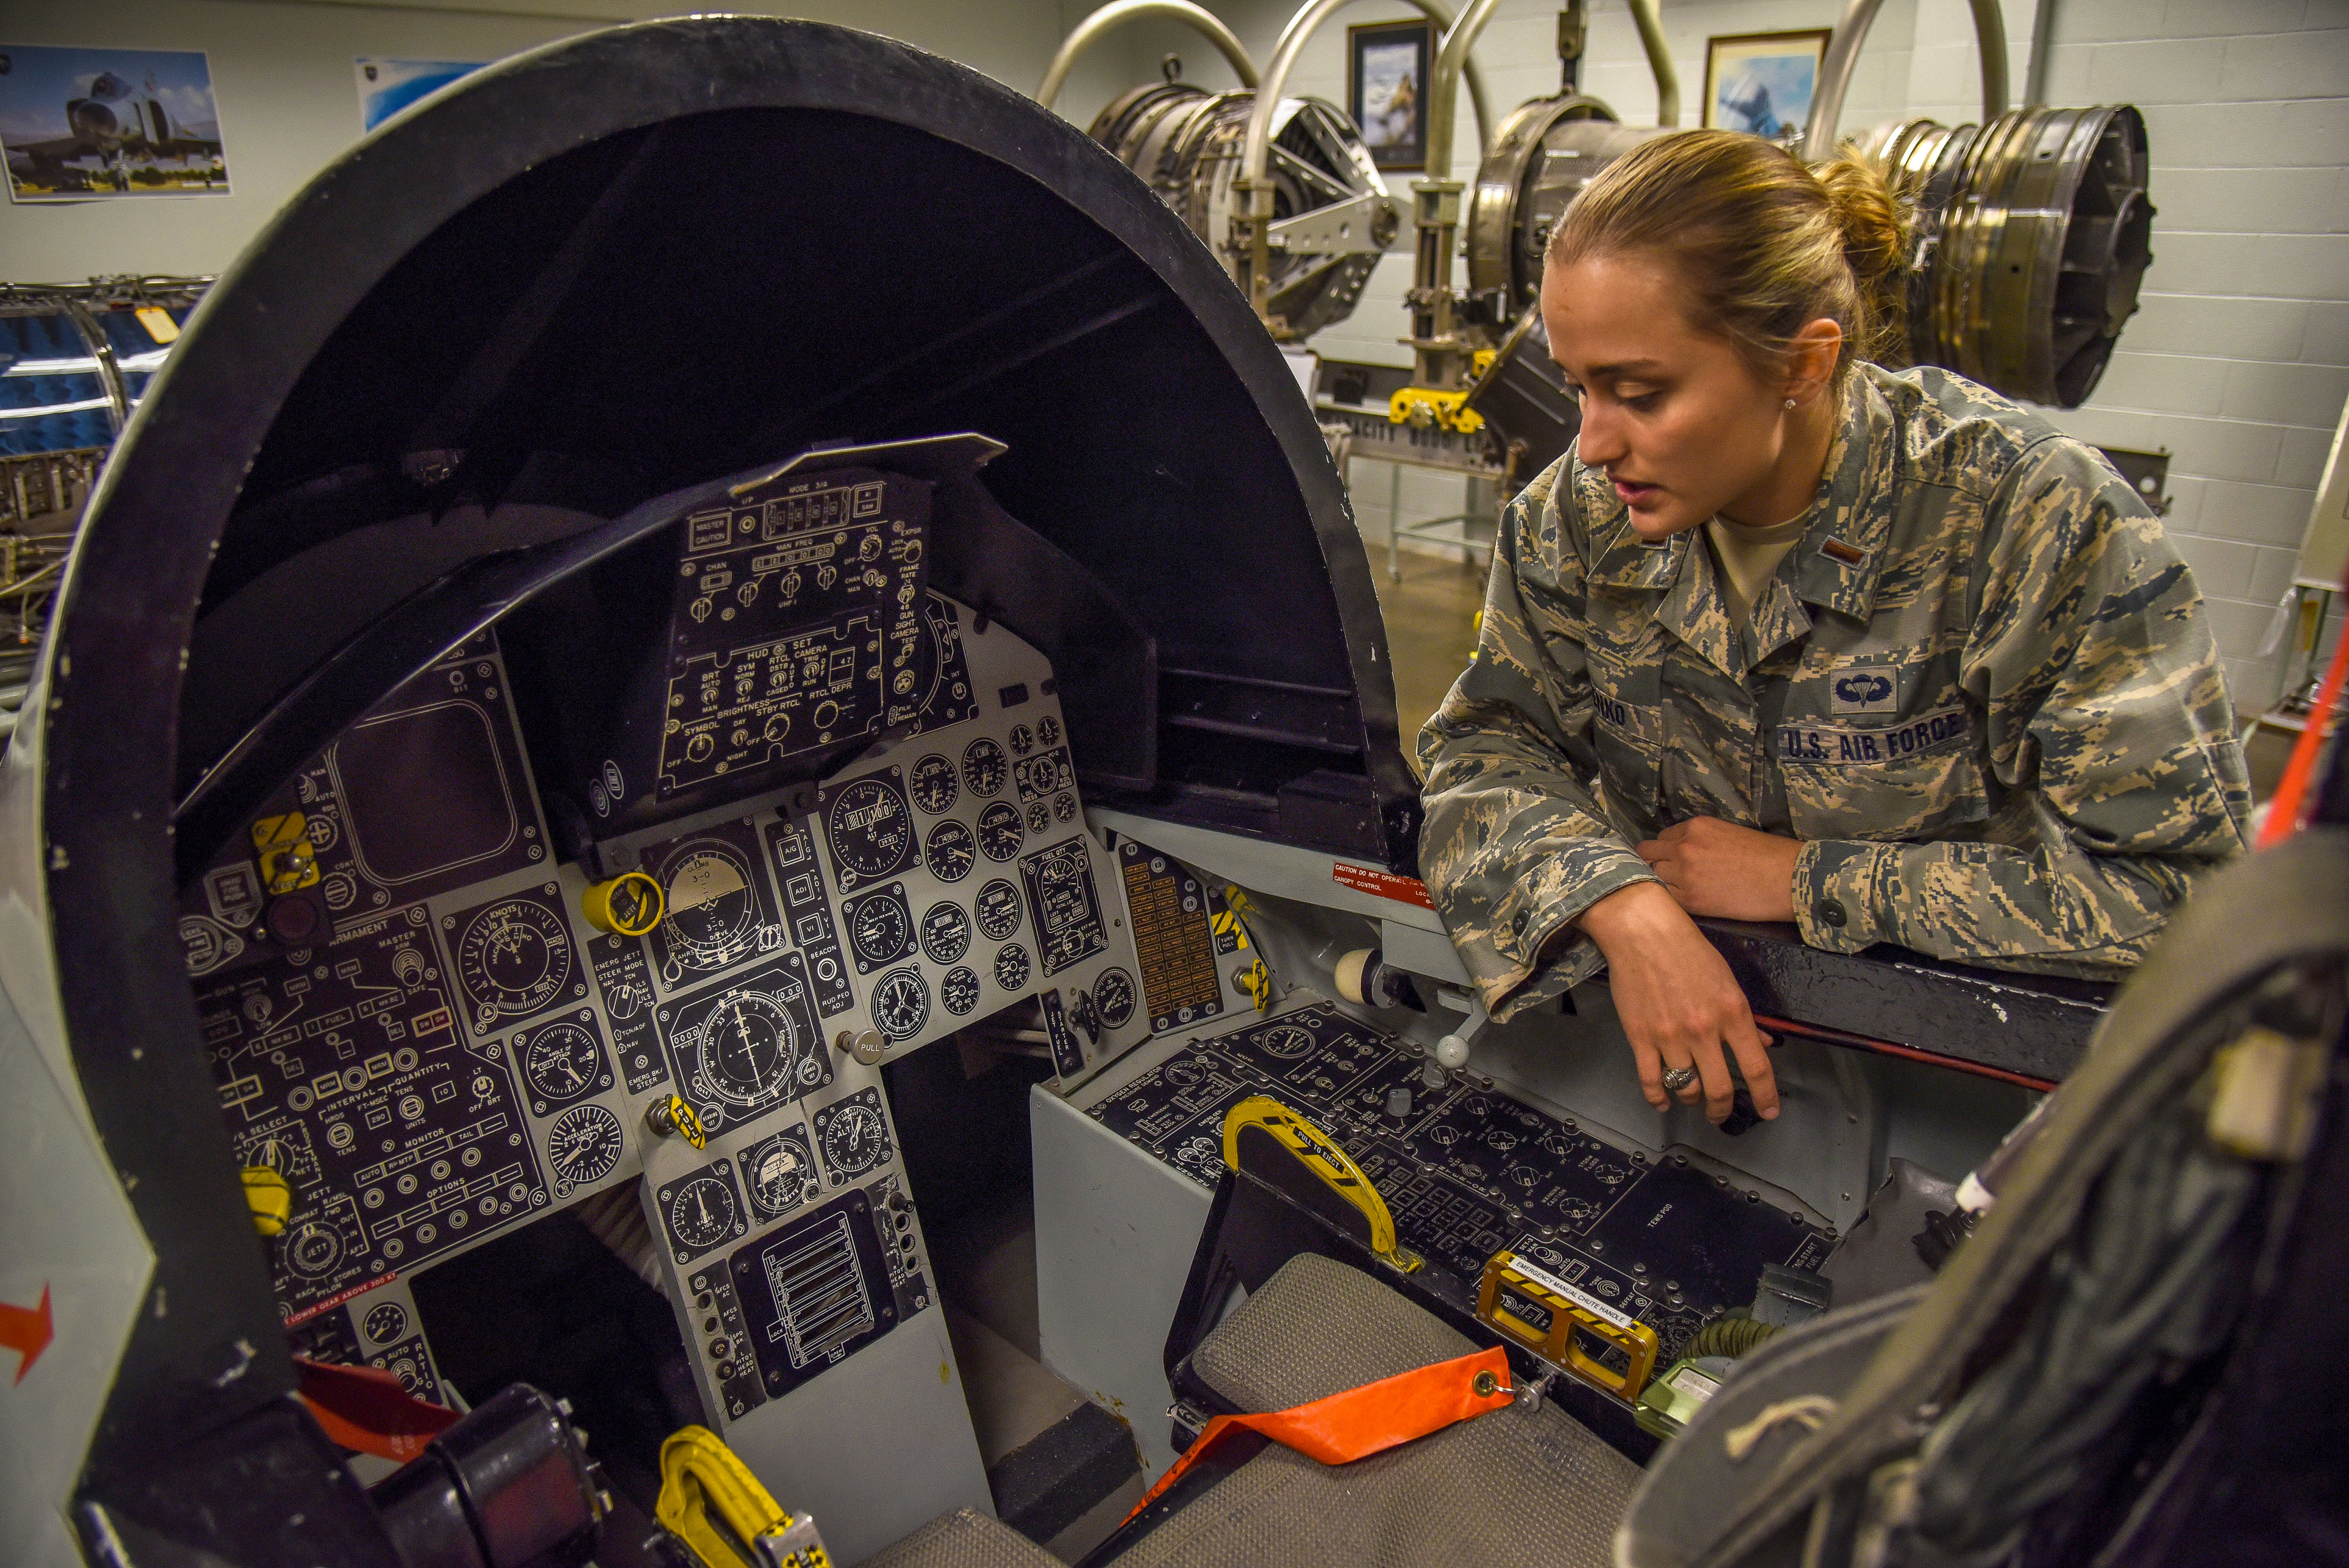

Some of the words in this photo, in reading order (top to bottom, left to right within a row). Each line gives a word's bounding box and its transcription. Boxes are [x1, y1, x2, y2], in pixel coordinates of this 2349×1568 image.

[706, 562, 726, 571] CHAN
[900, 564, 919, 572] FRAME
[900, 611, 914, 619] GUN
[896, 619, 915, 629] SIGHT
[891, 627, 919, 639] CAMERA
[748, 649, 768, 660] HUD
[793, 638, 812, 649] SET
[795, 645, 827, 658] CAMERA
[769, 656, 790, 664] RTCL
[738, 662, 755, 672] SYM
[770, 663, 788, 672] DSTB
[702, 671, 720, 681] BRT
[734, 671, 755, 680] NORM
[701, 680, 720, 689] AUTO
[809, 689, 829, 699] RTCL
[831, 682, 852, 693] DEPR
[766, 688, 788, 697] CAGED
[717, 697, 772, 719] BRIGHTNESS
[757, 705, 778, 716] STBY
[780, 699, 800, 709] RTCL
[734, 718, 746, 727] DAY
[898, 713, 916, 721] REMAIN
[685, 722, 720, 736] SYMBOL
[1788, 730, 1829, 759] U.S.
[1839, 734, 1881, 761] AIR
[1886, 713, 1962, 757] FORCE
[727, 750, 748, 761] NIGHT
[667, 759, 681, 768] OFF
[1021, 793, 1037, 803] PRESS
[868, 832, 877, 841] ALT
[882, 837, 896, 846] 29.92
[785, 846, 796, 854] A/G
[1042, 852, 1055, 861] FUEL
[1055, 847, 1066, 857] QTY
[1335, 865, 1357, 874] CAUTION
[1334, 876, 1354, 884] CANOPY
[1357, 881, 1381, 891] CONTROL
[796, 886, 806, 894] ADI
[490, 905, 517, 919] KNOTS
[379, 931, 416, 948] MASTER
[866, 934, 879, 943] DOWN
[678, 949, 695, 960] AHRS
[811, 945, 836, 959] BEACON
[595, 958, 619, 971] EMERG
[623, 950, 641, 962] JETT
[599, 968, 621, 980] STEER
[625, 960, 643, 971] MODE
[408, 985, 426, 995] SAFE
[638, 987, 648, 995] NAV
[643, 999, 654, 1008] TCN
[822, 997, 836, 1006] RUD
[836, 991, 850, 1001] PED
[831, 1001, 844, 1011] ADJ
[622, 1023, 645, 1035] TCN/ADF
[1057, 1011, 1069, 1051] STARTER
[861, 1043, 880, 1052] PULL
[1055, 1033, 1063, 1056] FUEL
[549, 1049, 564, 1058] ANGLE
[395, 1064, 440, 1085] QUANTITY
[472, 1067, 482, 1075] LT
[629, 1073, 653, 1087] EMERG
[651, 1067, 663, 1079] BK/
[636, 1076, 658, 1089] STEER
[1106, 1085, 1128, 1103] OXYGEN
[1128, 1066, 1163, 1089] REGULATOR
[395, 1085, 413, 1096] TENS
[327, 1089, 376, 1112] INTERVAL
[358, 1095, 390, 1114] FT-MSEC
[469, 1103, 483, 1113] OFF
[487, 1096, 501, 1106] BRT
[406, 1118, 426, 1129] UNITS
[678, 1108, 699, 1138] PULL
[1198, 1115, 1214, 1127] EMERG
[1212, 1109, 1223, 1118] GEN
[1209, 1116, 1220, 1125] AUTO
[251, 1117, 287, 1135] SELECT
[405, 1128, 445, 1148] MONITOR
[565, 1123, 602, 1142] ACCELERATION
[337, 1145, 356, 1156] TENS
[1297, 1131, 1312, 1146] PULL
[1314, 1143, 1321, 1153] TO
[1322, 1151, 1341, 1169] EJECT
[360, 1168, 381, 1182] AUTO
[307, 1187, 330, 1201] JETT
[427, 1178, 465, 1198] OPTIONS
[289, 1208, 318, 1224] COMBAT
[1648, 1213, 1663, 1227] TEWS
[1660, 1203, 1673, 1215] POD
[1519, 1238, 1533, 1250] SET-3
[1526, 1244, 1539, 1253] MAN
[1801, 1242, 1818, 1260] START
[1559, 1258, 1570, 1269] AUTO
[1806, 1256, 1821, 1269] FUEL
[333, 1266, 361, 1285] STORES
[889, 1267, 904, 1279] PITOT
[891, 1273, 905, 1283] HEAD
[892, 1279, 905, 1289] HEAT
[1589, 1276, 1602, 1286] TONE
[716, 1283, 730, 1295] AFCS
[1515, 1261, 1554, 1284] EMERGENCY
[1554, 1282, 1577, 1297] MANUAL
[1578, 1295, 1600, 1310] CHUTE
[1599, 1307, 1625, 1322] HANDLE
[1619, 1292, 1635, 1308] DEFEAT
[724, 1306, 737, 1321] AFCS
[771, 1327, 784, 1338] LOCK
[736, 1337, 744, 1346] BK
[388, 1346, 409, 1360] AUTO
[830, 1349, 843, 1359] OPEN
[737, 1352, 752, 1367] PITOT
[739, 1361, 754, 1371] HEAD
[740, 1367, 754, 1377] HEAT
